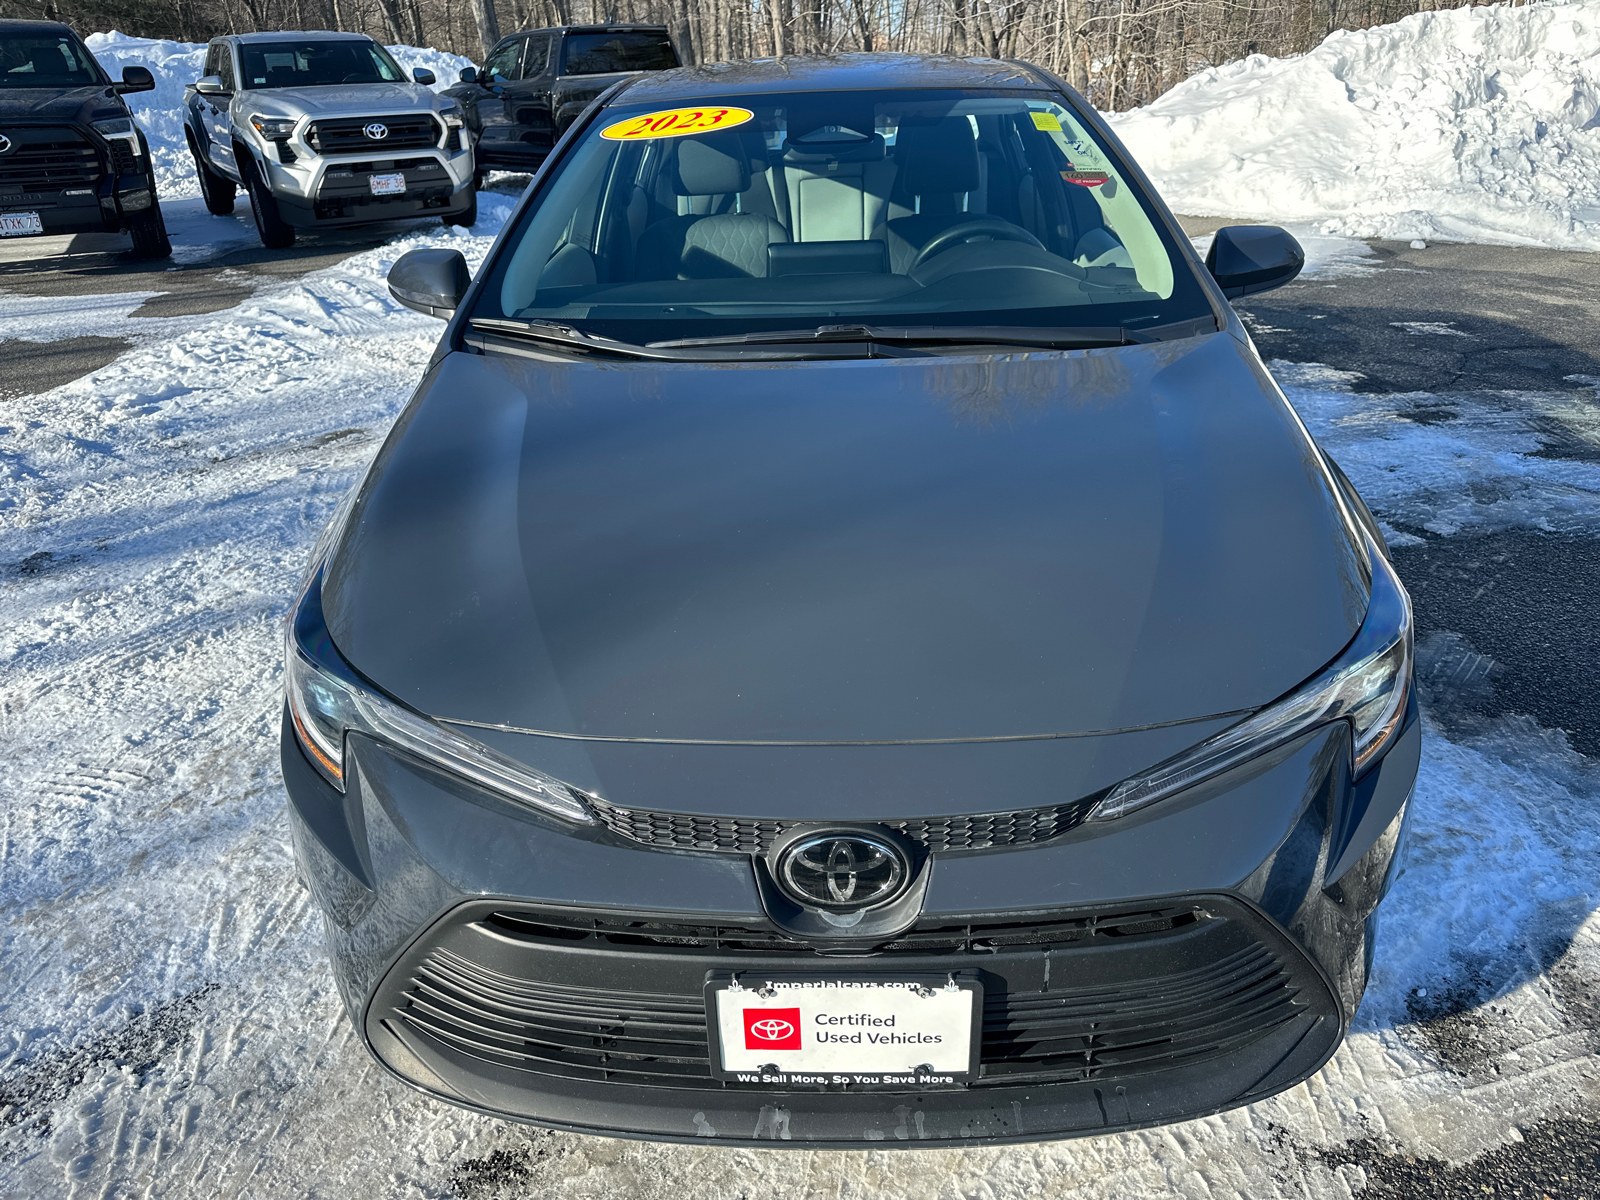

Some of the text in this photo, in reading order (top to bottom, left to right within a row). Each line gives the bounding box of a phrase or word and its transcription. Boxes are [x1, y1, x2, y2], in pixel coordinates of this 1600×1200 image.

[622, 110, 728, 137] 2023
[393, 177, 405, 188] 38
[26, 216, 41, 228] 73
[815, 1013, 895, 1027] Certified
[816, 1031, 942, 1044] Used Vehicles
[737, 1074, 954, 1085] We Sell More, So You Save More
